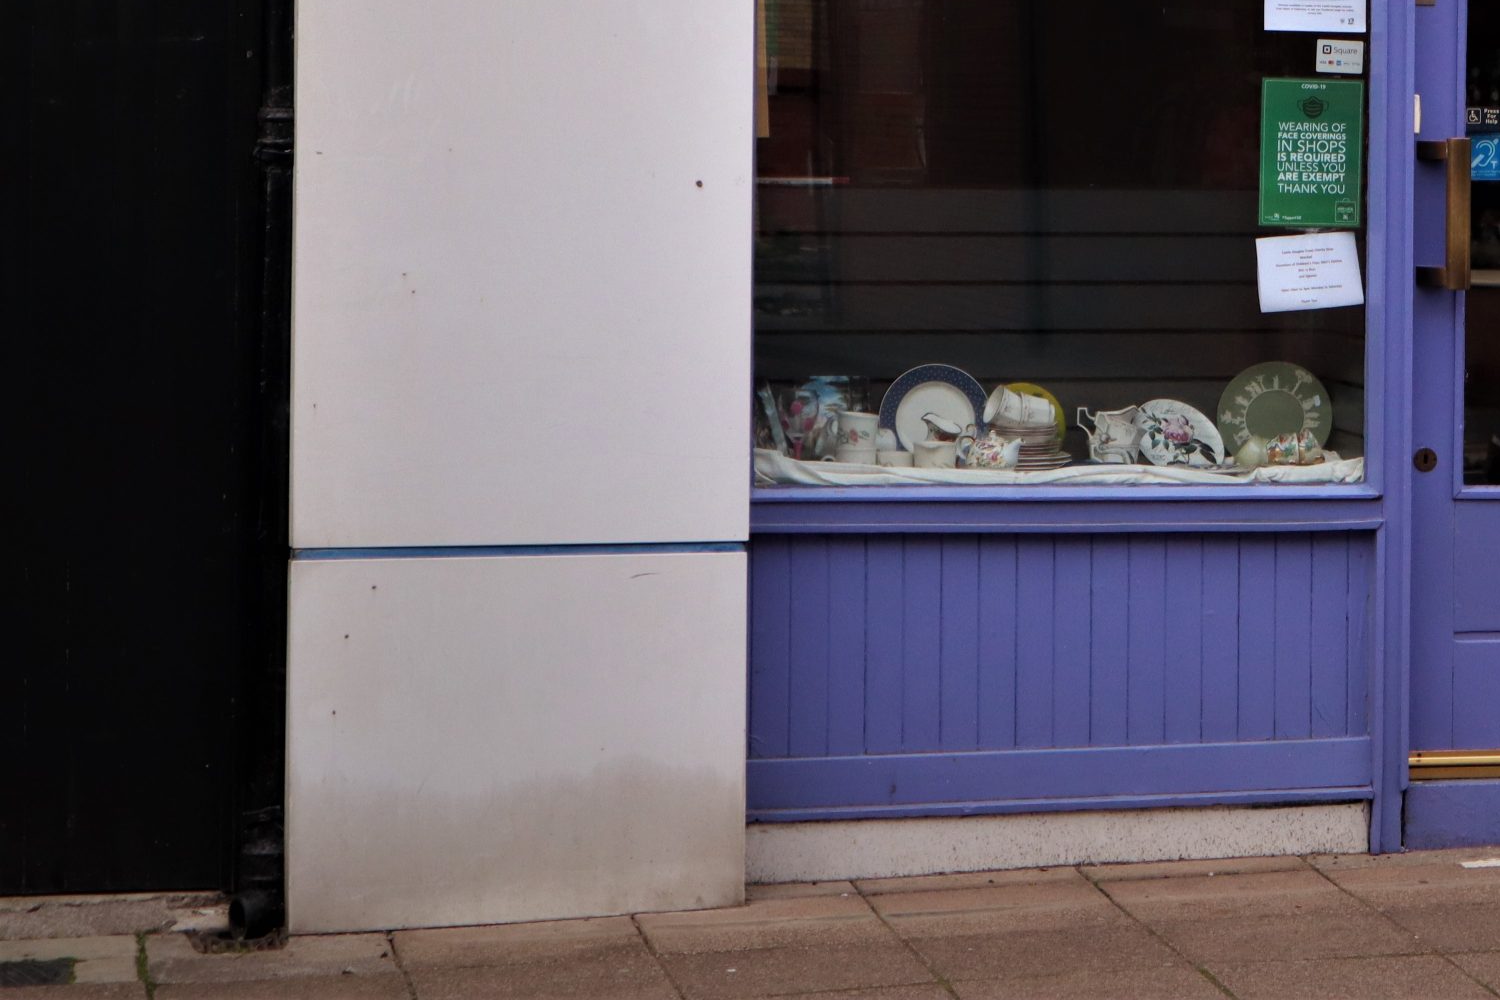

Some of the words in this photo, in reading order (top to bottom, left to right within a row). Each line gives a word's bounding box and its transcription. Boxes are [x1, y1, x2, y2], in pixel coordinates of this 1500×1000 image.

[1333, 46, 1358, 56] Square
[1279, 122, 1328, 132] WEARING
[1332, 123, 1346, 132] OF
[1278, 140, 1292, 151] IN
[1297, 140, 1346, 153] SHOPS
[1278, 153, 1286, 161] IS
[1290, 153, 1345, 162] REQUIRED
[1277, 162, 1318, 172] UNLESS
[1322, 163, 1345, 172] YOU
[1278, 172, 1298, 181] ARE
[1302, 173, 1345, 182] EXEMPT
[1277, 183, 1317, 193] THANK
[1321, 184, 1345, 194] YOU
